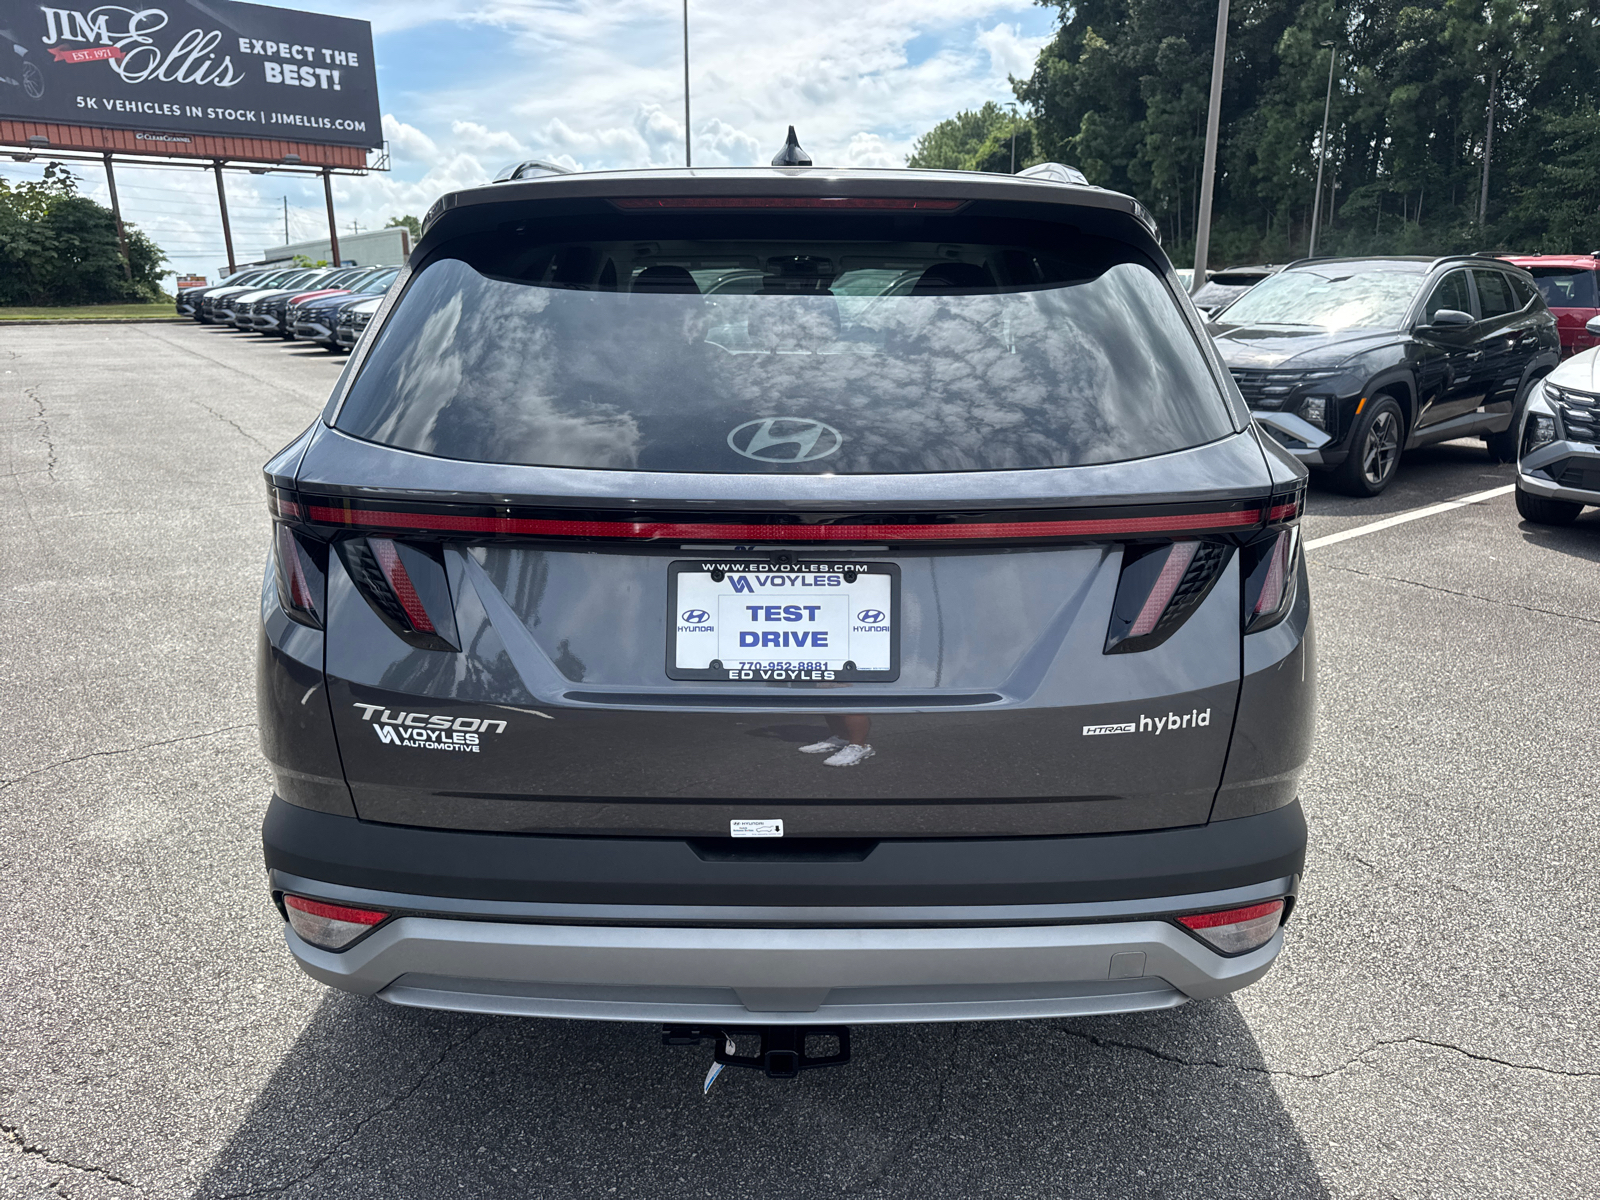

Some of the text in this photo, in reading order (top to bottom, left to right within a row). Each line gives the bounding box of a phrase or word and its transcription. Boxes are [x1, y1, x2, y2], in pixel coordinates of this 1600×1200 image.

[40, 5, 246, 87] JIM Ellis
[238, 37, 359, 67] EXPECT THE
[72, 49, 112, 62] EST. 1971
[263, 61, 342, 91] BEST!
[76, 96, 367, 132] 5K VEHICLES IN STOCK JIMELLIS.COM
[701, 563, 868, 572] WWW.EDVOYLES.COM
[754, 575, 841, 587] VOYLES
[745, 605, 821, 622] TEST
[677, 625, 715, 633] HYUNDAI
[853, 625, 890, 633] HYUNDAI
[739, 631, 829, 648] DRIVE
[738, 661, 829, 671] 770-952-8881
[728, 670, 836, 681] ED VOYLES
[1086, 708, 1211, 735] HTRAC hybrid
[398, 726, 480, 745] VOYLES
[402, 739, 481, 753] AUTOMOTIVE
